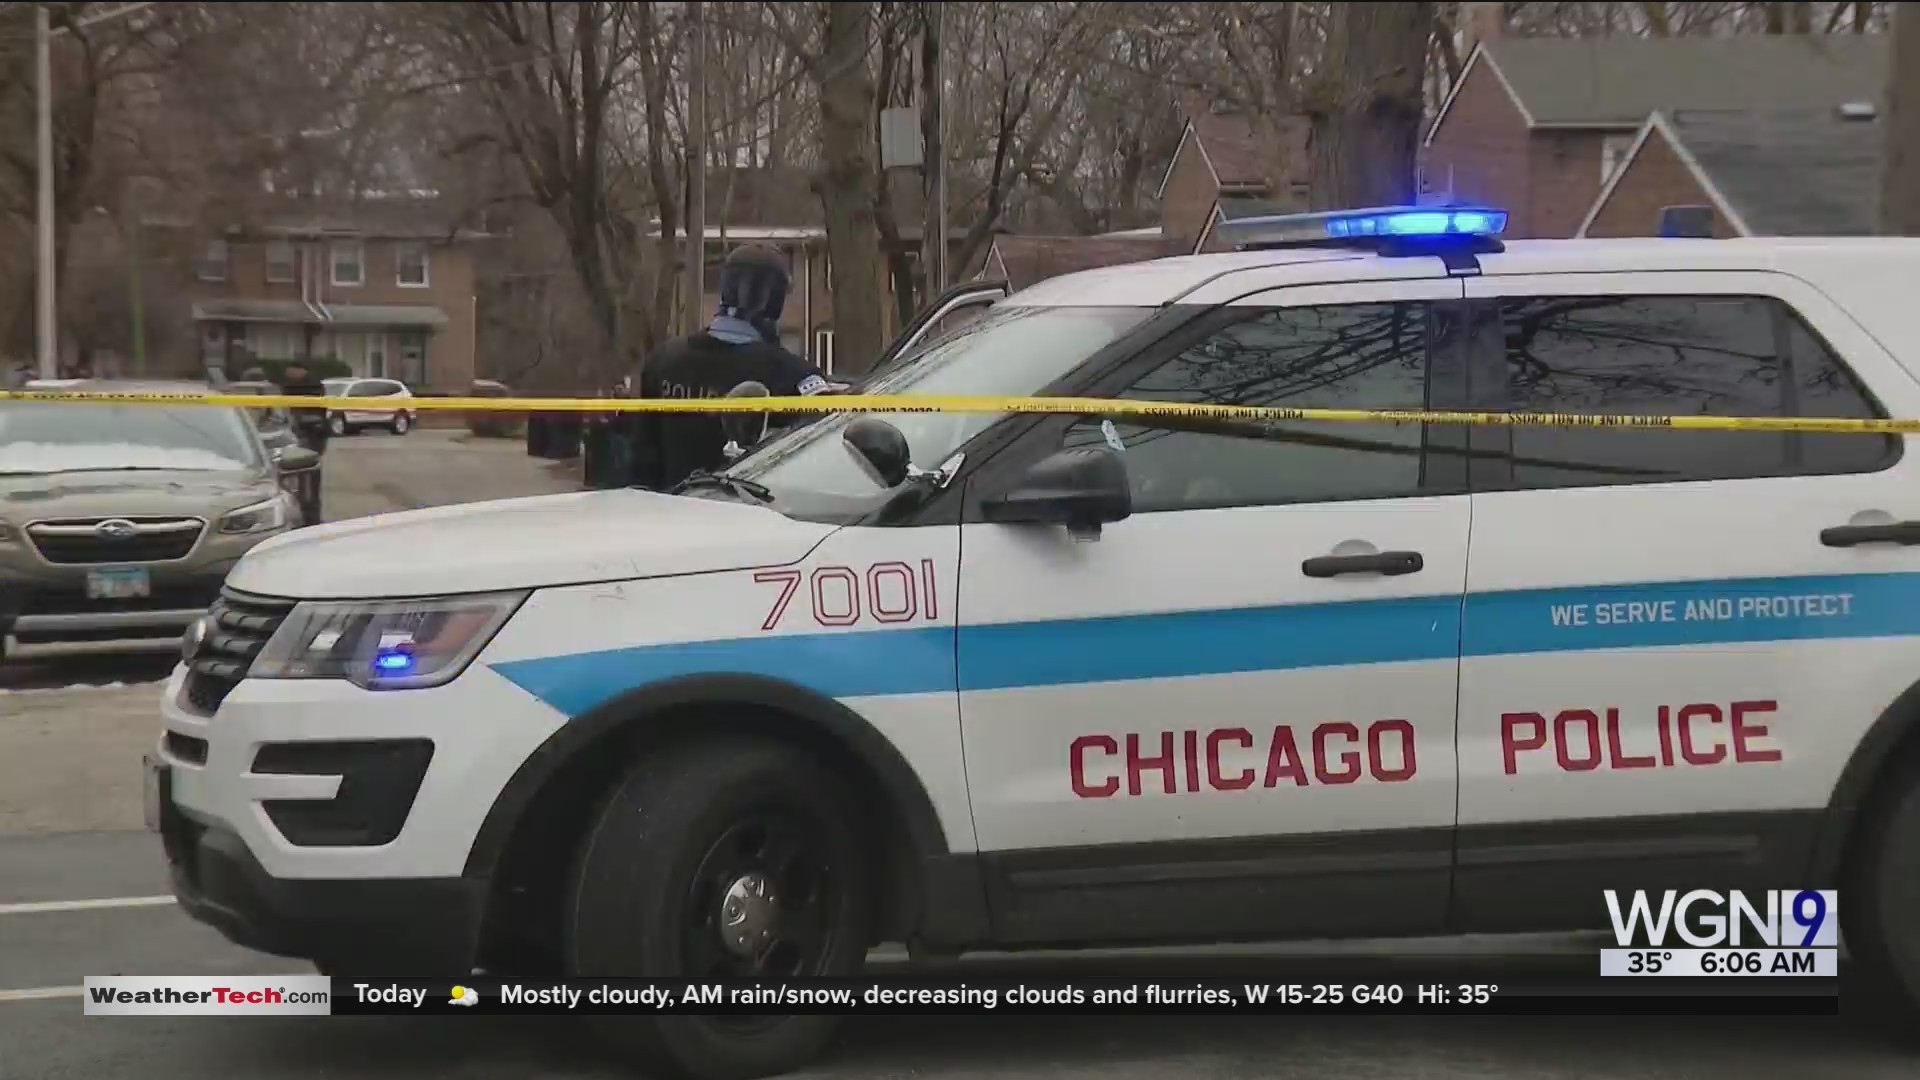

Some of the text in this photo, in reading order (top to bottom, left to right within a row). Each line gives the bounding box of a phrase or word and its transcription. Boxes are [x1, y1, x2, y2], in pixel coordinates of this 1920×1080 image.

[753, 559, 937, 630] 7001
[1551, 593, 1853, 626] WE SERVE AND PROTECT
[1070, 700, 1782, 798] CHICAGO POLICE
